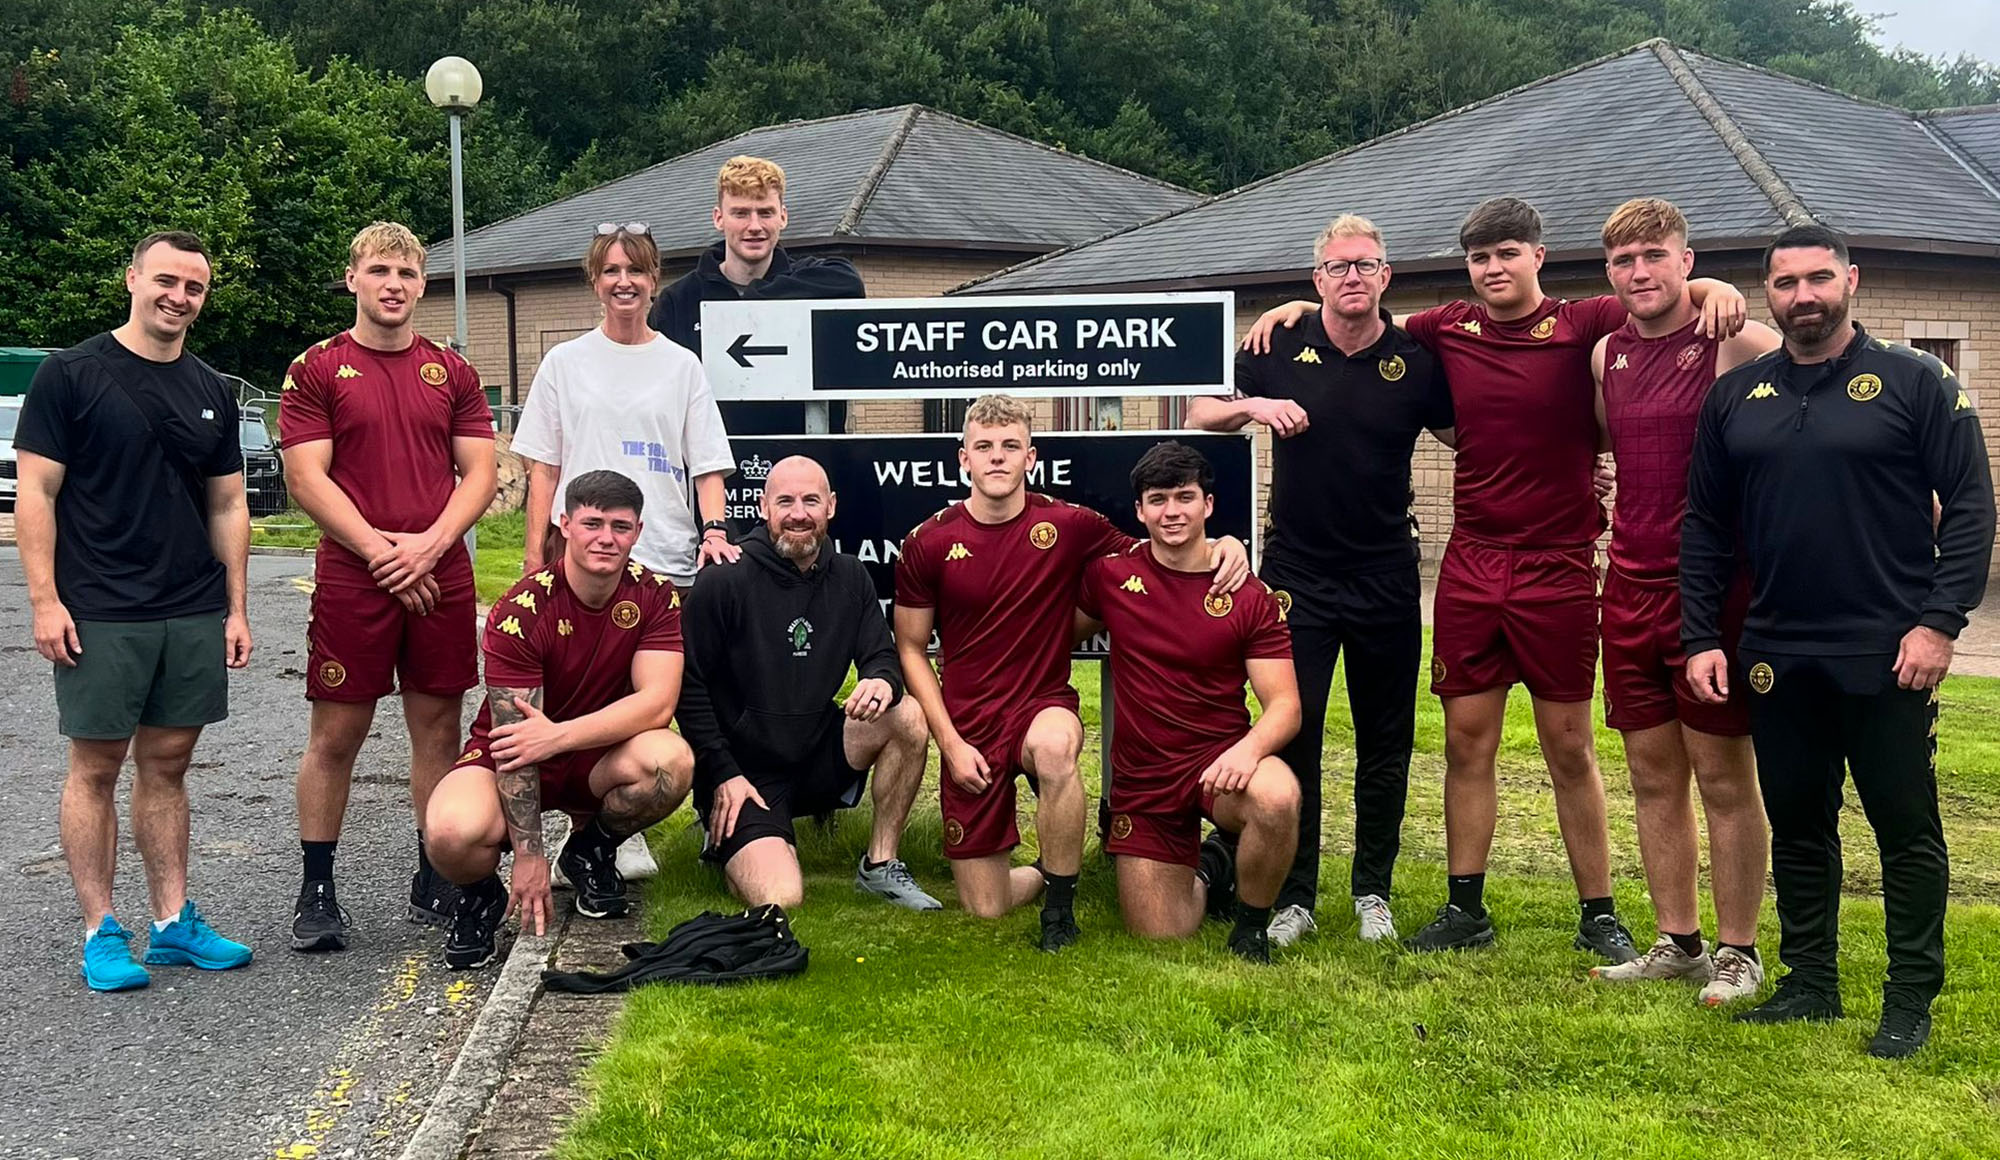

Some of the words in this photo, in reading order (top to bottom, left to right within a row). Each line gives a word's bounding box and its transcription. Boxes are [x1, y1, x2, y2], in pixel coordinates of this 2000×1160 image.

[856, 322, 965, 351] STAFF
[981, 320, 1059, 351] CAR
[1077, 318, 1176, 349] PARK
[892, 360, 1004, 379] Authorised
[1012, 359, 1089, 381] parking
[1096, 358, 1142, 379] only
[873, 459, 1071, 487] WELME
